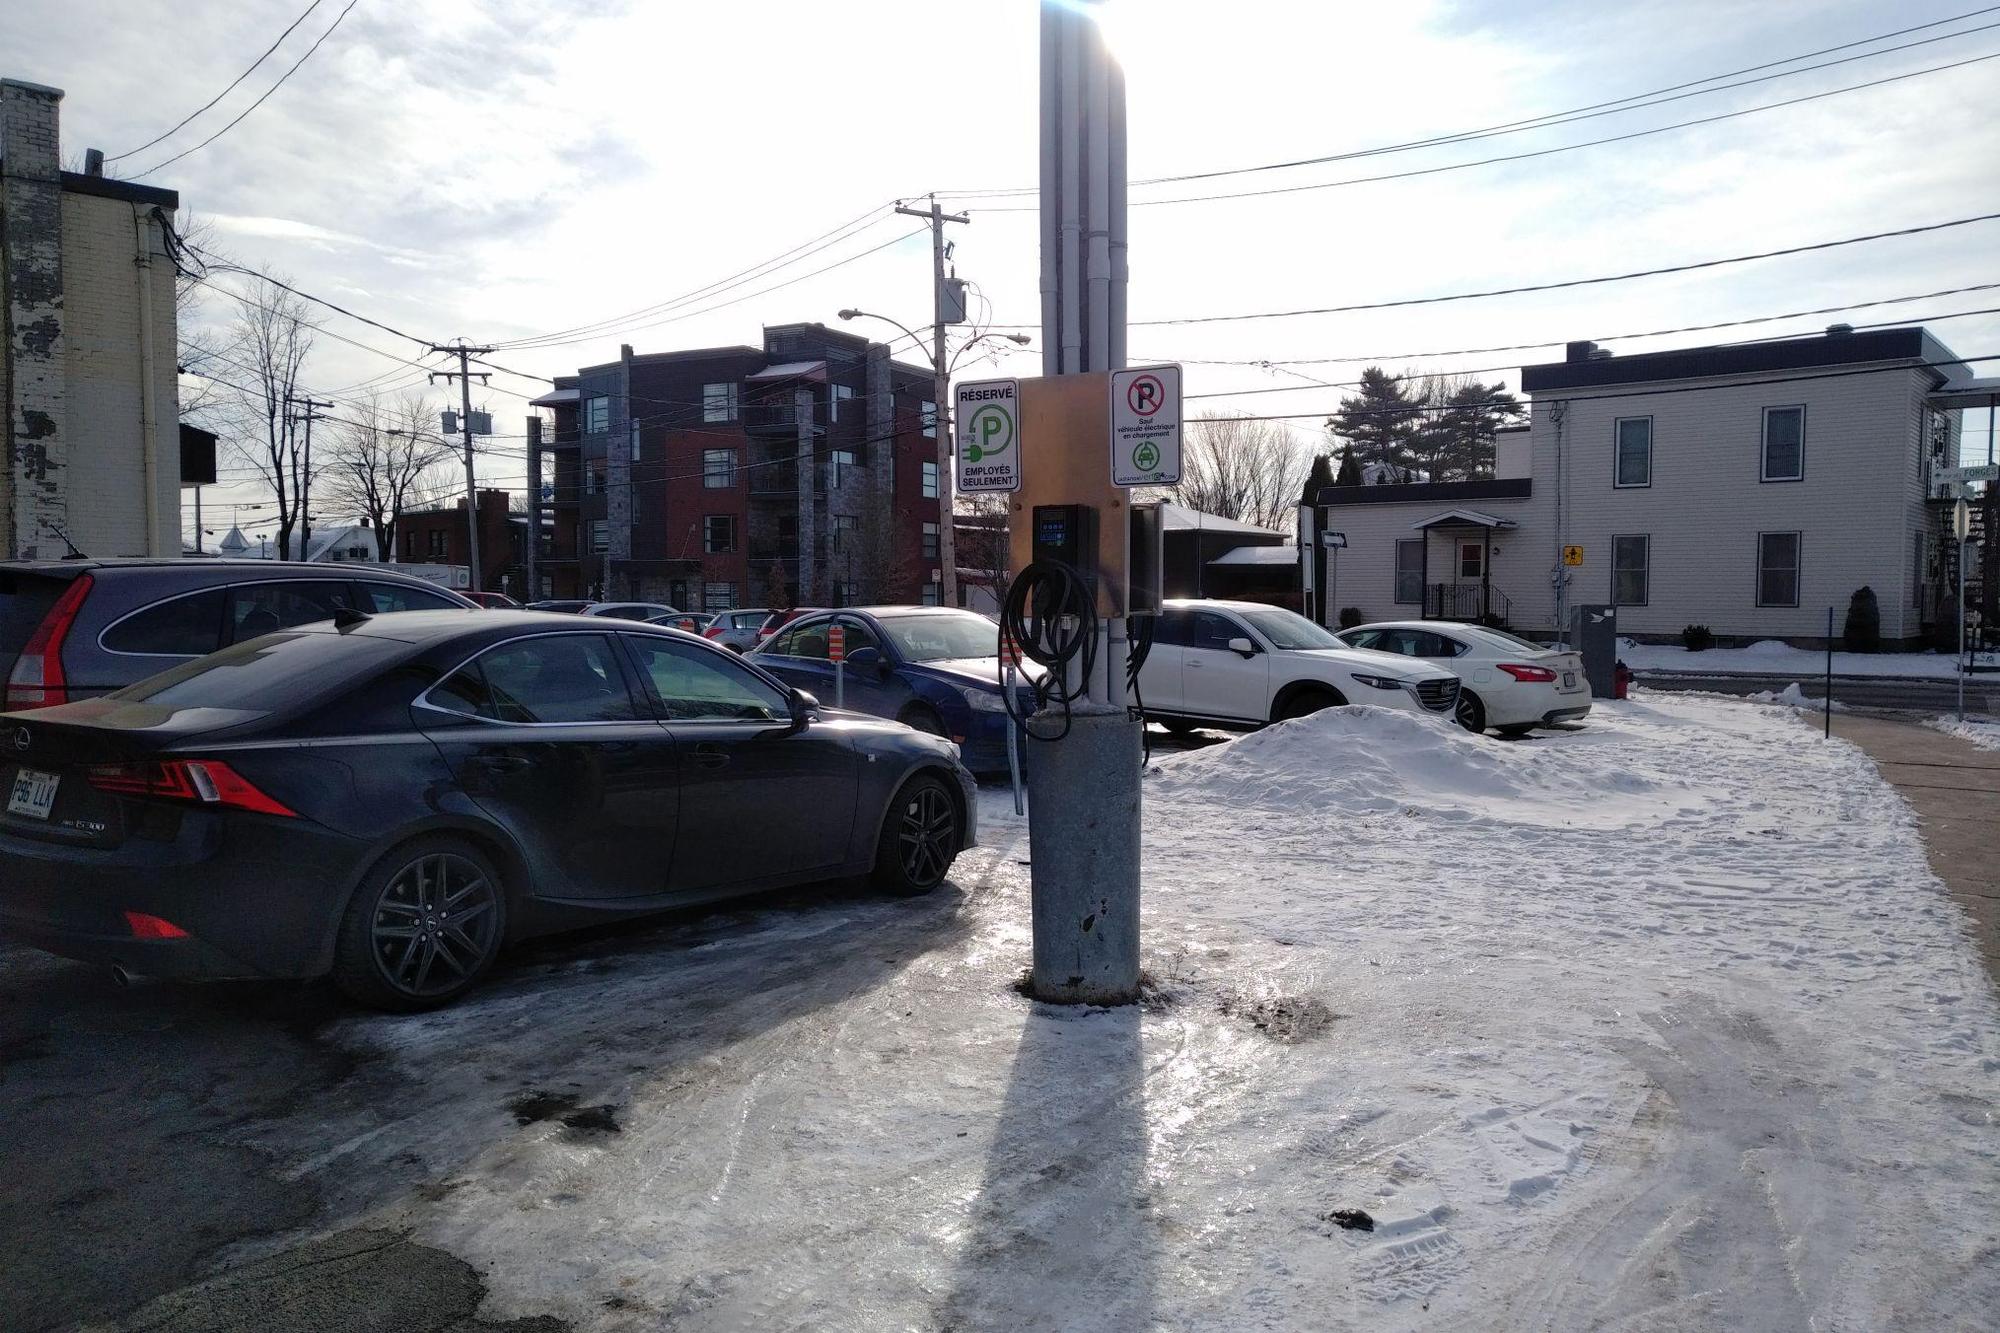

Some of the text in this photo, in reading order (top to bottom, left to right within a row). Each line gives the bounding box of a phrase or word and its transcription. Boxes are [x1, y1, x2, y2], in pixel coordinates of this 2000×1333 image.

[960, 386, 1013, 402] RÉSERVÉ
[983, 416, 1002, 446] P
[1117, 424, 1176, 433] véhicule électrique
[1132, 430, 1170, 438] chargement
[965, 464, 1011, 476] EMPLOYÉS
[1964, 467, 1996, 477] FORGES
[963, 476, 1013, 487] SEULEMENT
